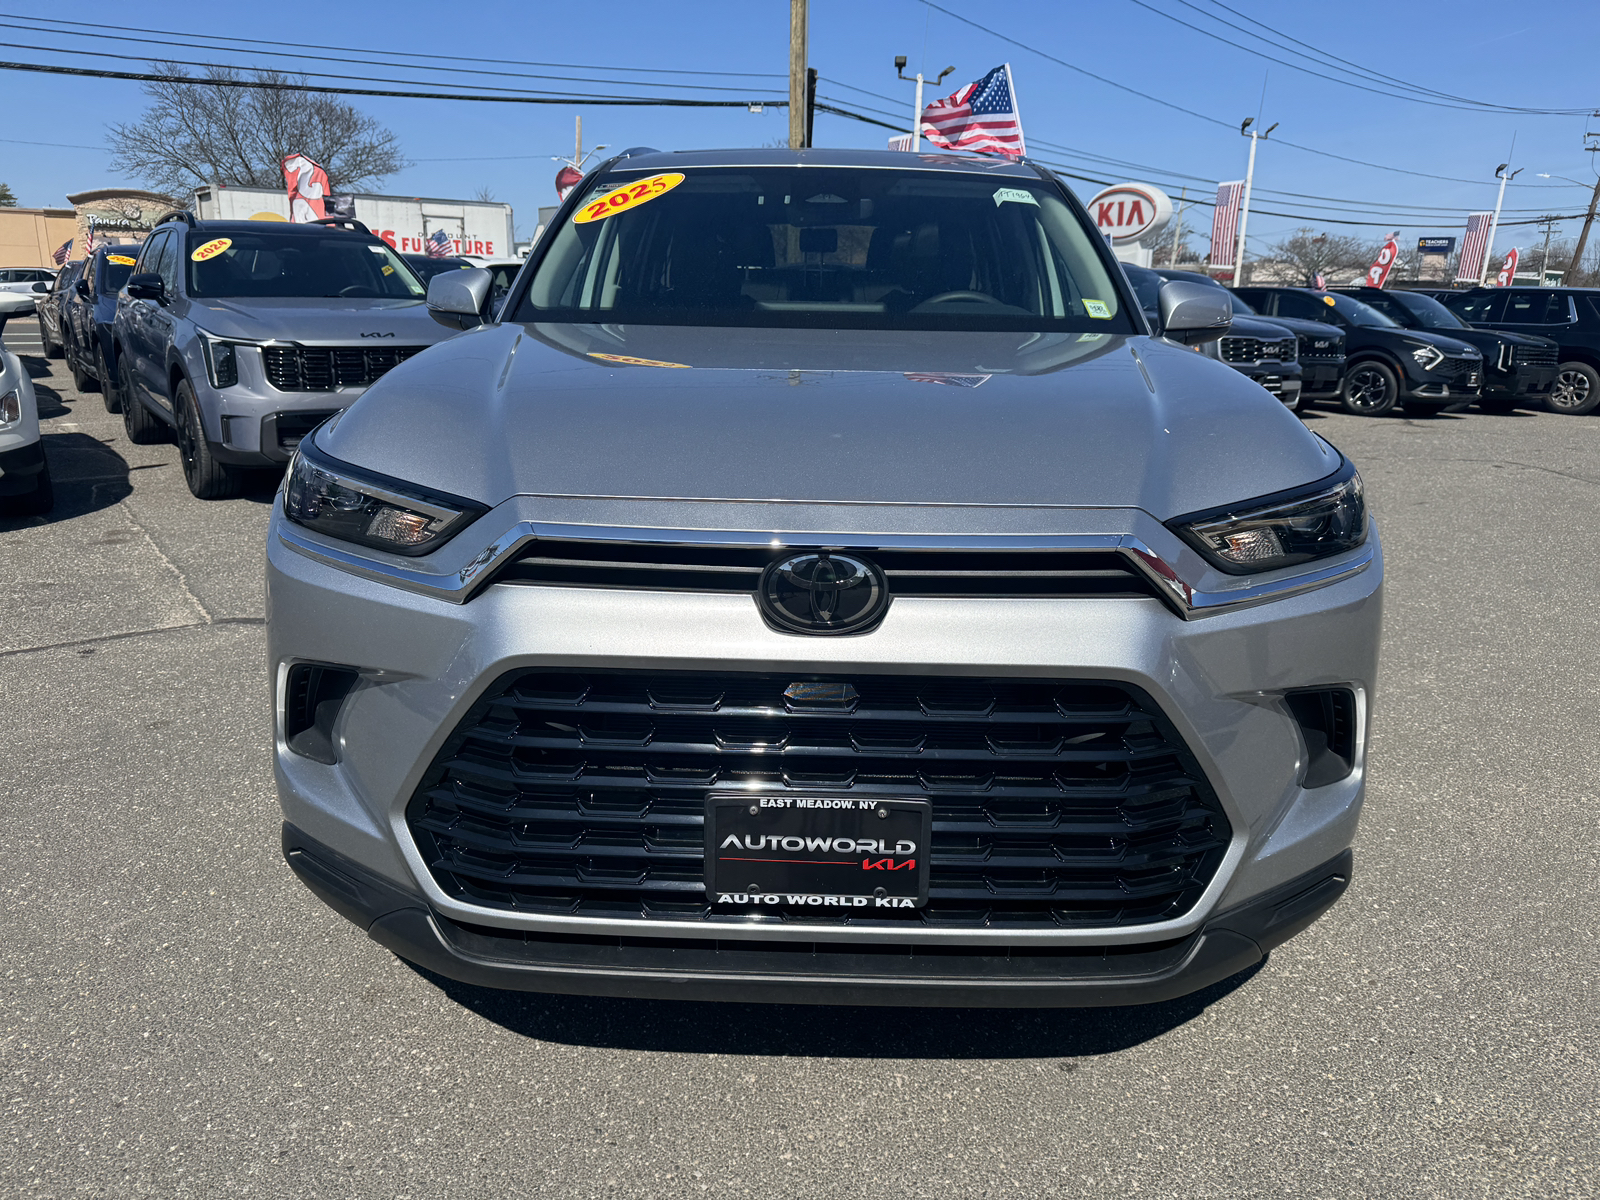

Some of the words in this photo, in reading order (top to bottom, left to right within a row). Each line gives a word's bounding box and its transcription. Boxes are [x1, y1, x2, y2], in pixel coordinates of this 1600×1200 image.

[587, 177, 667, 219] 2025
[86, 213, 130, 226] Panera
[1097, 199, 1145, 227] KIA
[196, 239, 228, 259] 2024
[401, 237, 494, 255] FUTURE
[759, 798, 793, 809] EAST
[859, 801, 878, 811] NY
[719, 833, 917, 856] AUTOWORLD
[862, 857, 916, 871] KIA
[717, 893, 780, 905] AUTO
[786, 894, 869, 907] WORLD
[875, 897, 916, 909] KIA
